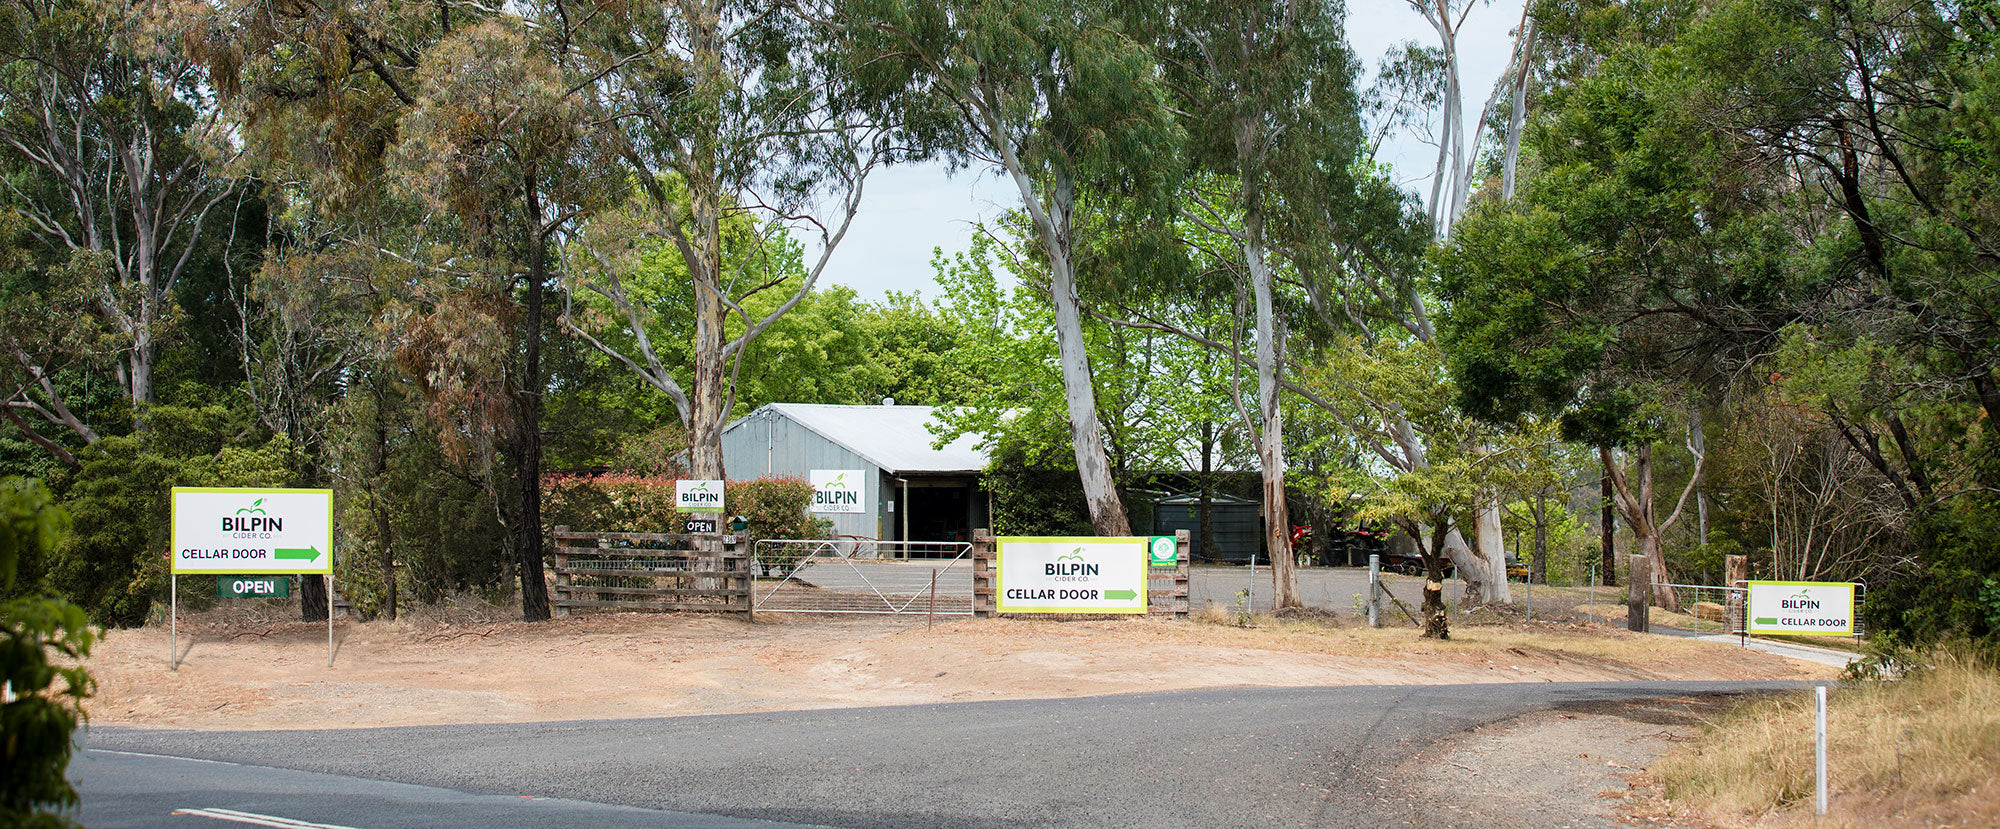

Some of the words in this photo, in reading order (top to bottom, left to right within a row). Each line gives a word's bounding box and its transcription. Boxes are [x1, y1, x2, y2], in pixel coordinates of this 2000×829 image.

[682, 493, 718, 502] BILPIN
[816, 491, 857, 504] BILPIN
[222, 517, 283, 532] BILPIN
[687, 522, 712, 532] OPEN
[182, 549, 229, 559] CELLAR
[232, 549, 267, 559] DOOR
[1045, 563, 1099, 576] BILPIN
[232, 580, 275, 594] OPEN
[1007, 589, 1056, 600] CELLAR
[1060, 589, 1098, 600] DOOR
[1781, 600, 1820, 609] BILPIN
[1781, 617, 1816, 626] CELLAR
[1818, 618, 1847, 627] DOOR
